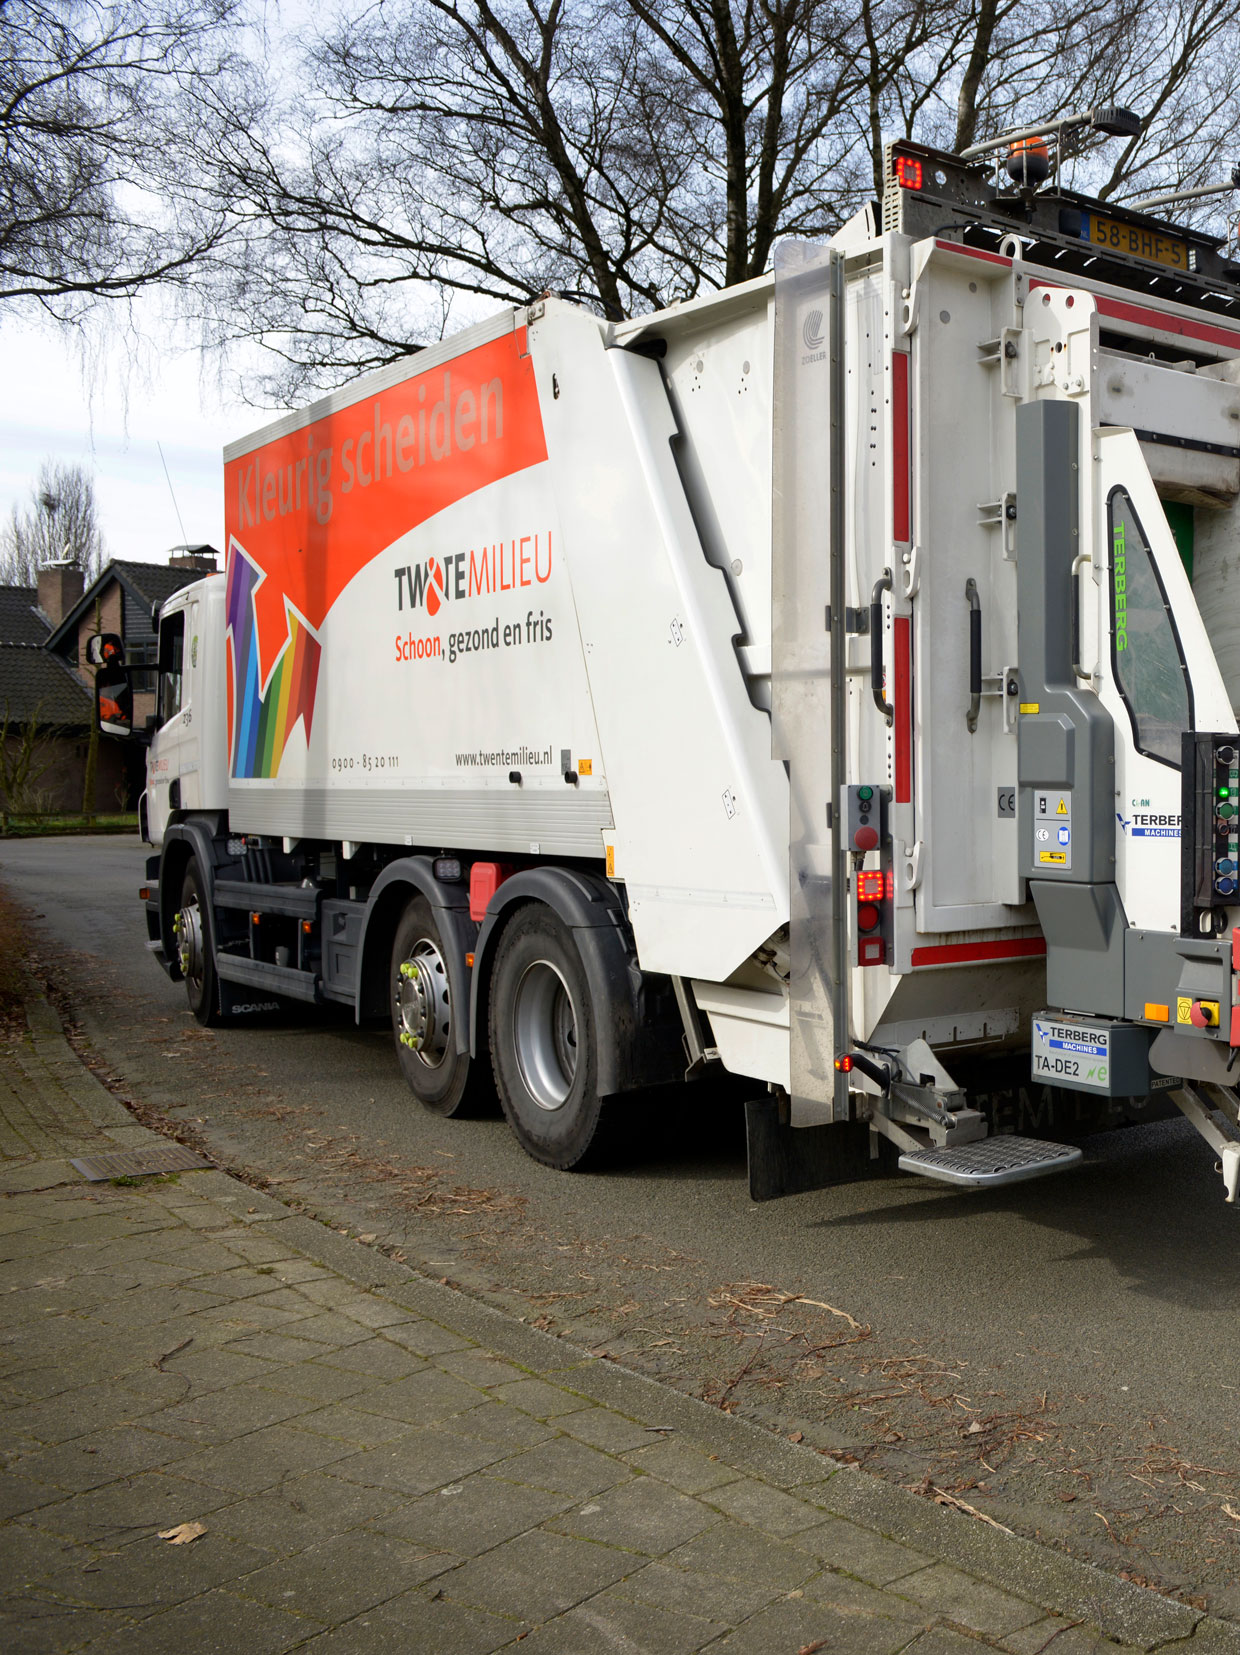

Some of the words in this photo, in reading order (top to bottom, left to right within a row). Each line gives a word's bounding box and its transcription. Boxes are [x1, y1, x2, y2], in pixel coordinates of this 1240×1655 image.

[1096, 220, 1182, 264] 58-BHF-5
[238, 433, 333, 530] Kleurig
[341, 371, 504, 493] scheiden
[1113, 520, 1128, 652] TERBERG
[395, 632, 445, 662] Schoon,
[448, 617, 500, 663] gezond
[503, 622, 522, 646] en
[525, 610, 553, 644] fris
[332, 756, 354, 772] 0900
[362, 753, 372, 771] 85
[375, 756, 385, 768] 20
[455, 745, 553, 767] www.twentemilieu.nl
[231, 1001, 280, 1014] SCANIA
[1050, 1027, 1107, 1045] TERBERG
[1062, 1043, 1098, 1054] MACHINES
[1035, 1054, 1080, 1077] TA-DE2
